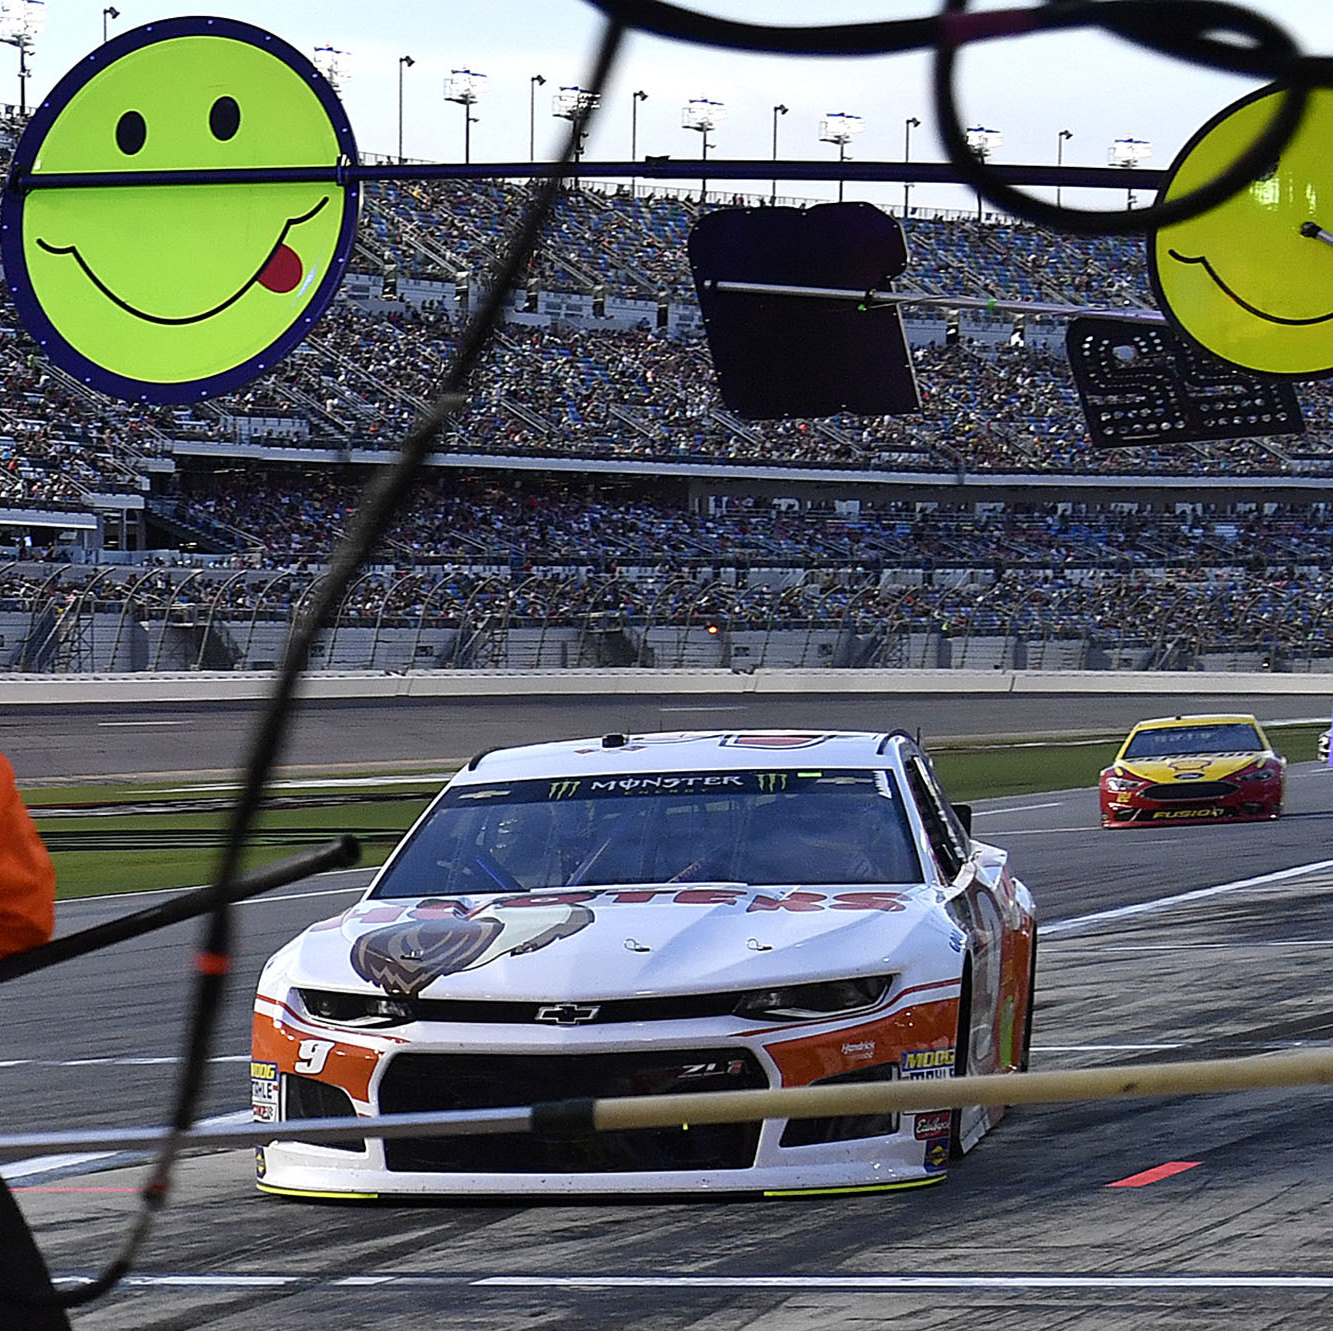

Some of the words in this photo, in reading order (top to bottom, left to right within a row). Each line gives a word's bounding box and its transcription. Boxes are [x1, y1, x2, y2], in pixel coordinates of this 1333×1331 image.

[589, 775, 744, 791] MONSTER
[1152, 808, 1225, 819] FUSION
[294, 1038, 336, 1075] 9
[905, 1049, 955, 1069] MOOG
